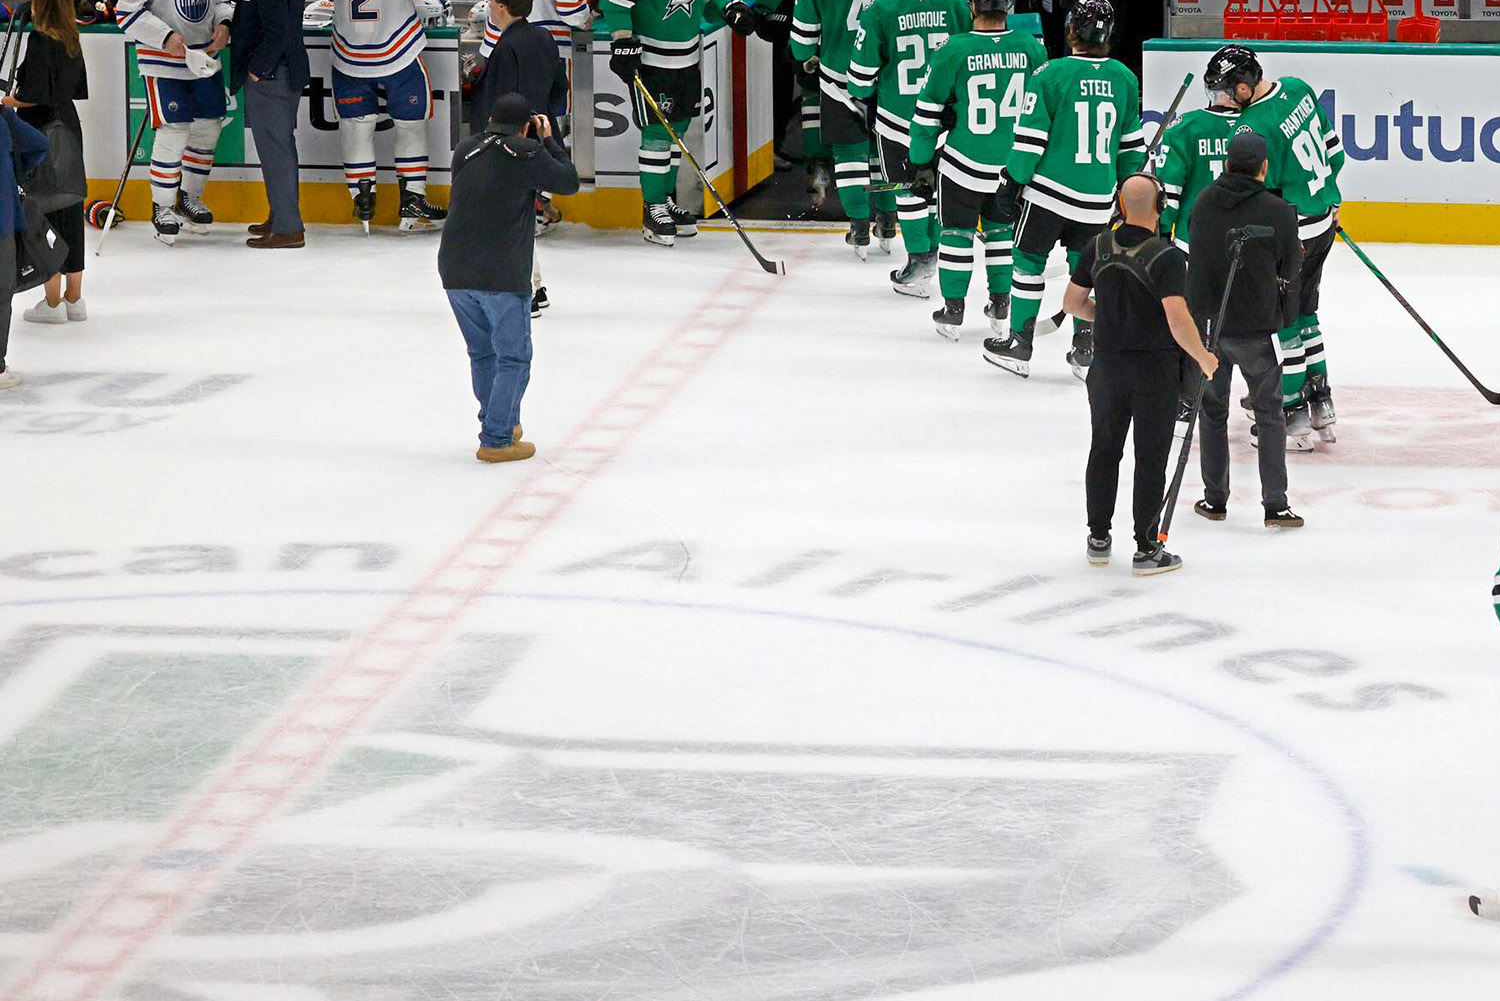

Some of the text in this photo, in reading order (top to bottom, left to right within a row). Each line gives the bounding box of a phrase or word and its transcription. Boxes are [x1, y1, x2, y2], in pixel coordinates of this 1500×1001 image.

[897, 10, 948, 32] BOURQUE
[1096, 20, 1104, 29] 18
[967, 52, 1028, 73] GRANLUND
[1080, 78, 1115, 99] STEEL
[966, 72, 1026, 136] 64
[1279, 93, 1316, 140] RANTANEN
[1074, 100, 1118, 165] 18
[1199, 138, 1229, 157] BLAC
